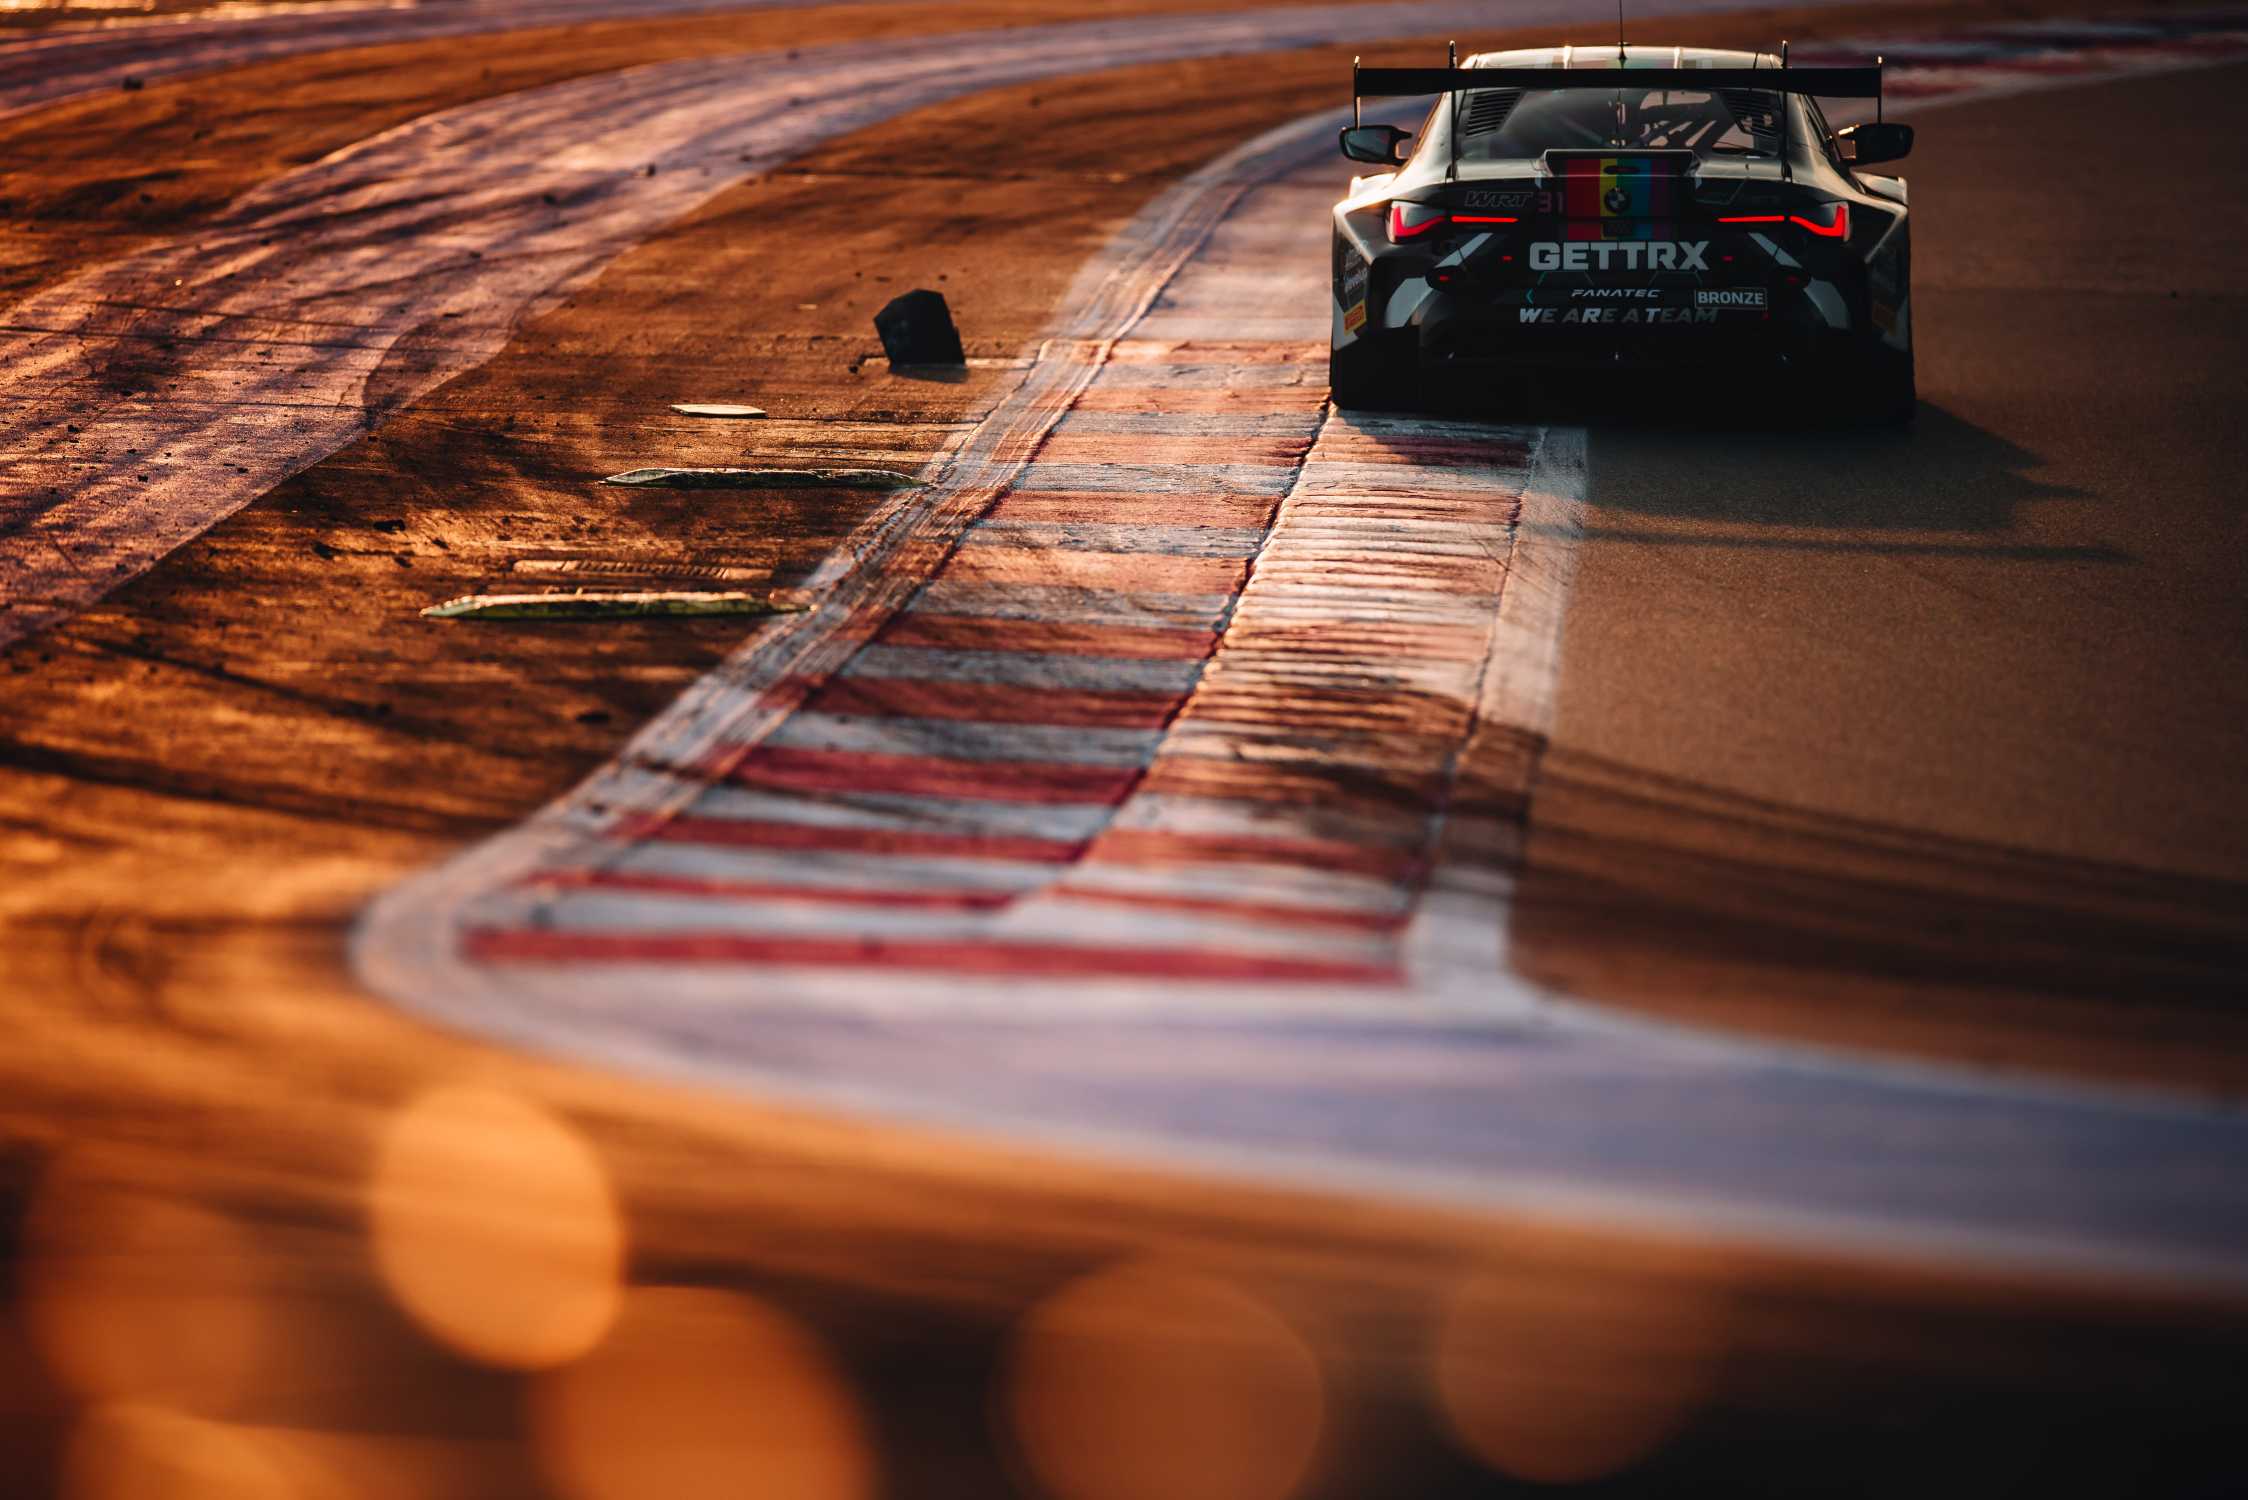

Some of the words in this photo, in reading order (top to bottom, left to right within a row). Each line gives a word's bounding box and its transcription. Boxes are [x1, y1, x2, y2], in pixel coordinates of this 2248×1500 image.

[1537, 191, 1564, 214] 31
[1529, 241, 1709, 270] GETTRX
[1571, 288, 1661, 297] FANATEC
[1697, 291, 1764, 305] BRONZE
[1519, 307, 1558, 323] WE
[1562, 307, 1616, 323] ARE
[1622, 307, 1641, 323] A
[1645, 307, 1719, 323] TEAM
